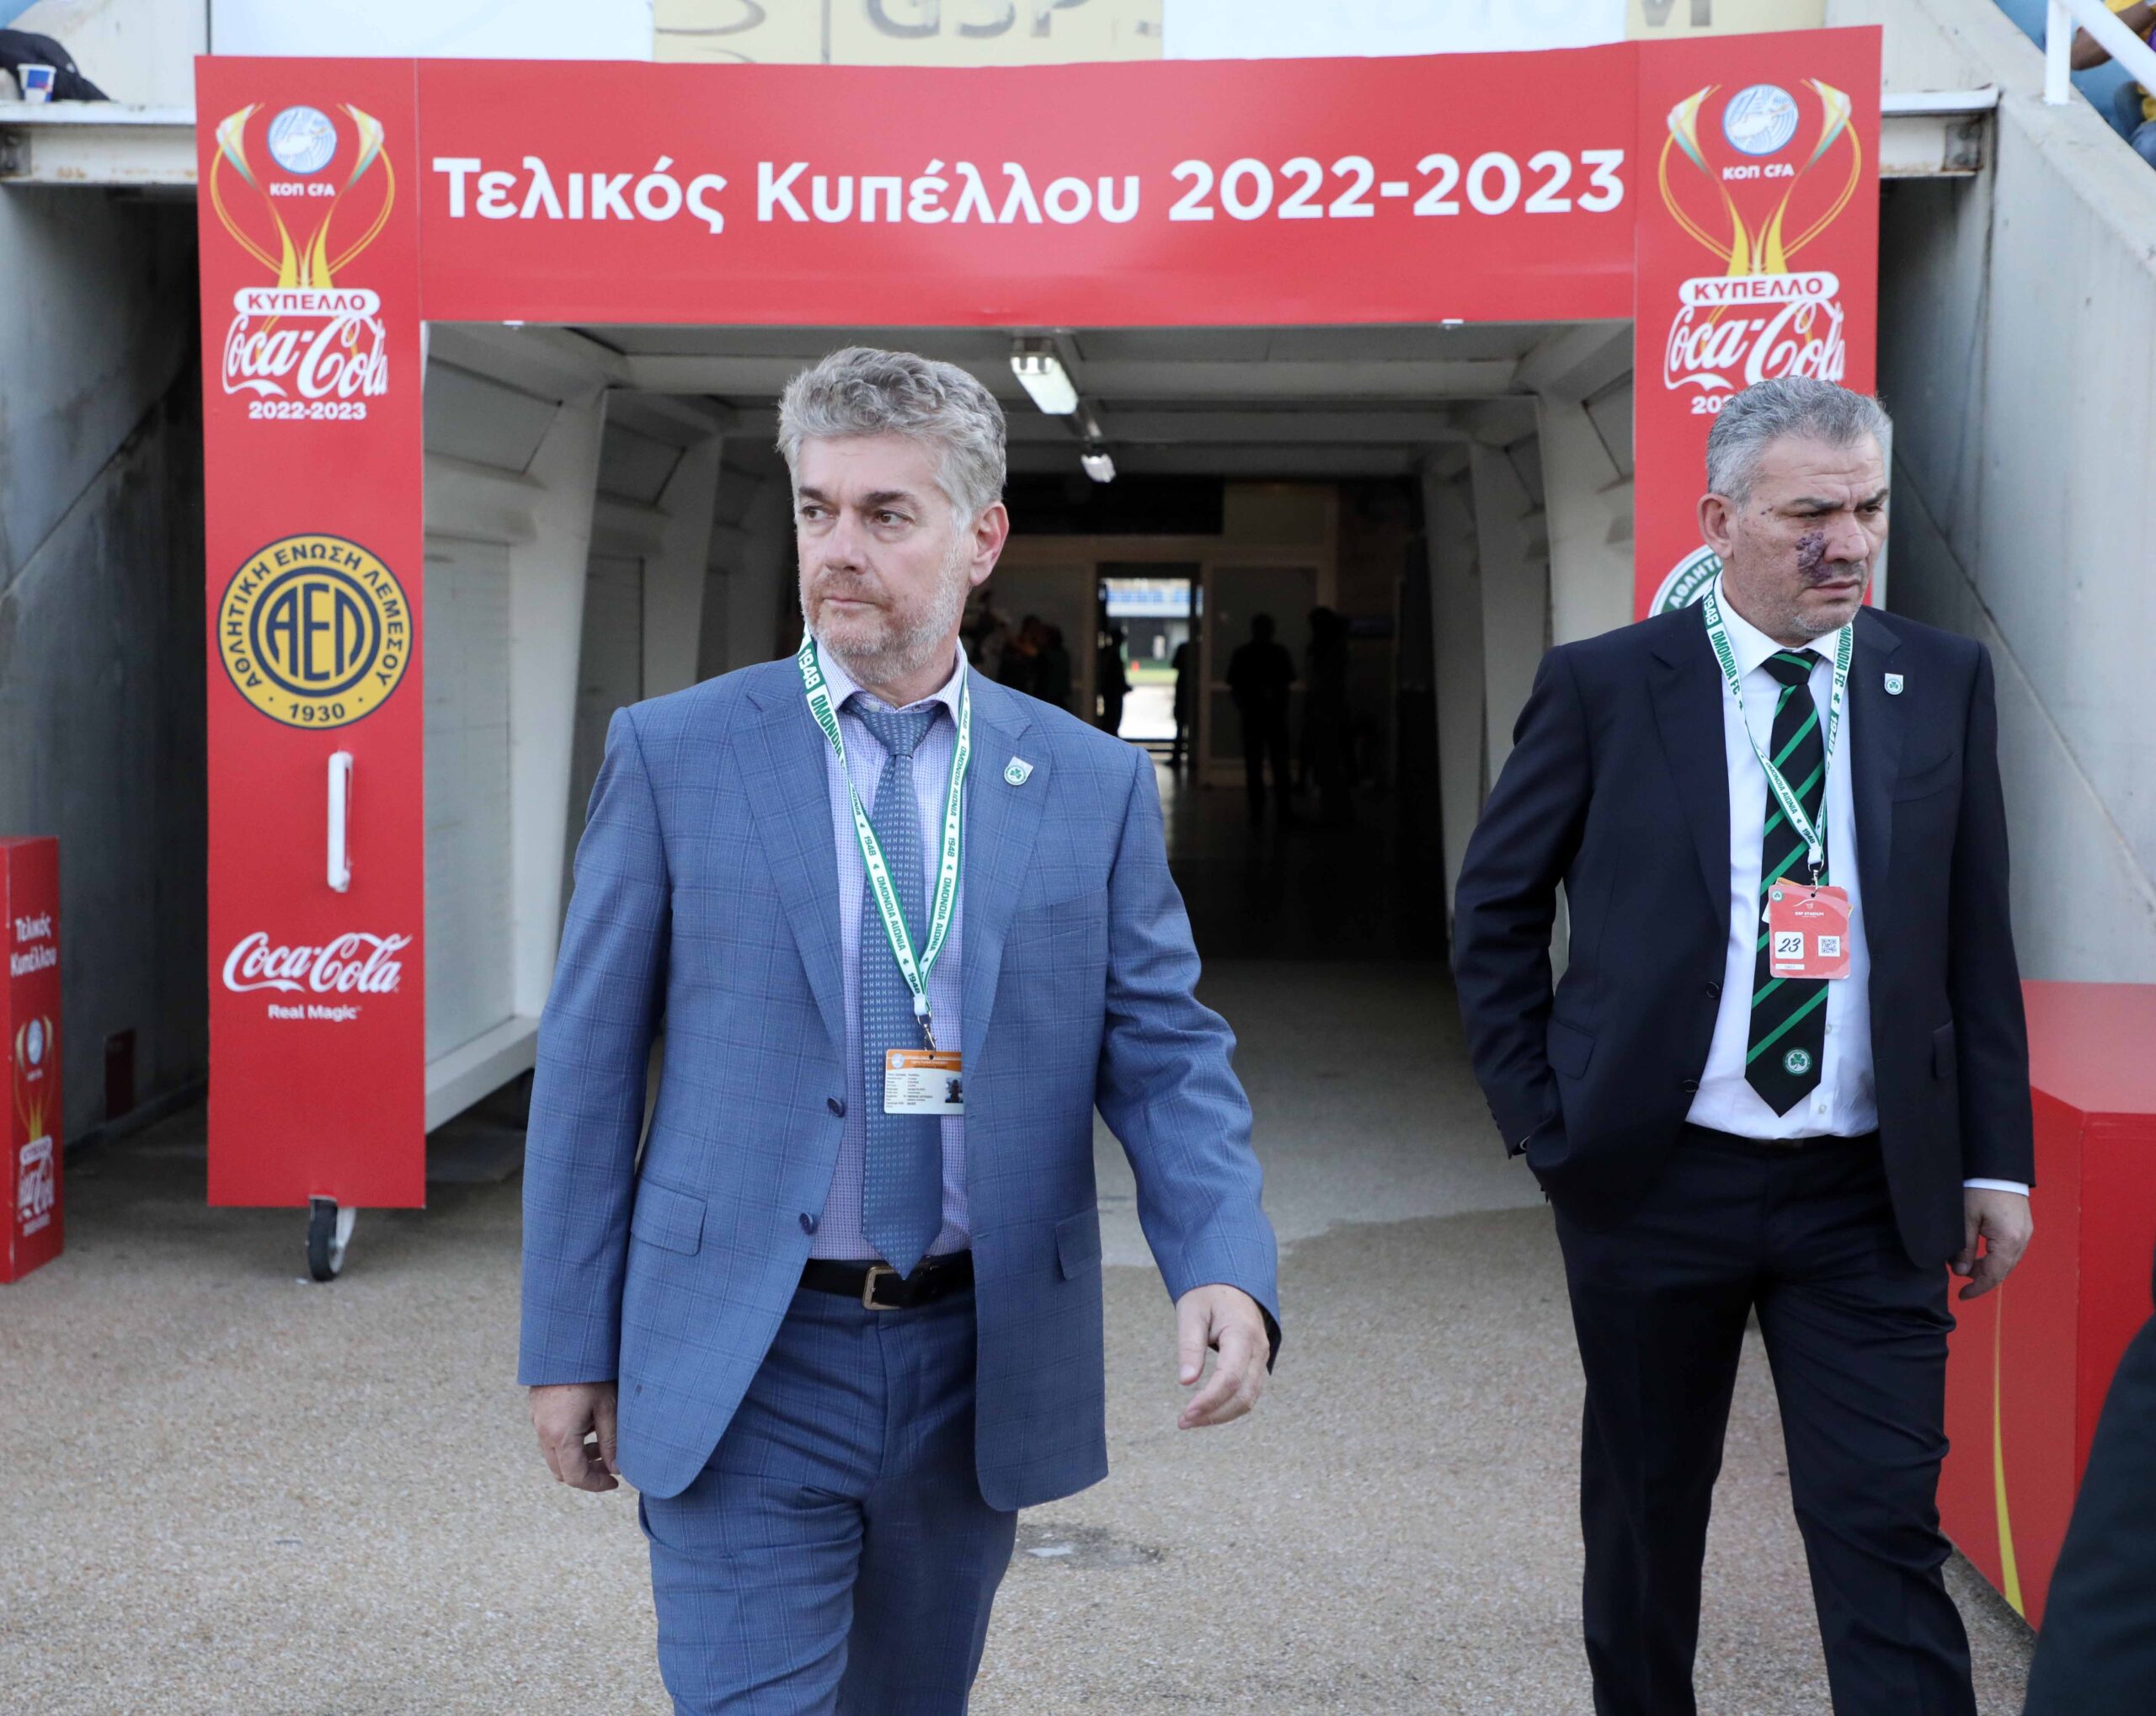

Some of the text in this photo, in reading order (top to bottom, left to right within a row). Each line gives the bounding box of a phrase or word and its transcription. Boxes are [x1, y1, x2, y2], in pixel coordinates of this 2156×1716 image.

[270, 184, 336, 196] ΚΟΠ CFA
[433, 149, 1625, 234] Τελικός Κυπέλλου 2022-2023
[1722, 163, 1795, 180] ΚΟΠ CFA
[248, 294, 366, 311] ΚΥΠΕΛΛΟ
[1694, 278, 1823, 301] ΚΥΠΕΛΛΟ
[222, 314, 388, 398] Coca-Cola
[1664, 299, 1845, 390] Coca-Cola
[248, 401, 366, 420] 2022-2023
[1669, 556, 1722, 609] ΑΘΛΗΤΙ
[227, 543, 403, 689] ΑΘΛΗΤΙΚΗ ΕΝΩΣΗ ΛΕΜΕΣΟΥ
[1704, 594, 1741, 695] 1948 OMONOIA FC
[1836, 626, 1852, 671] OMONOIA
[1834, 670, 1846, 688] FC
[289, 703, 345, 722] 1930
[798, 647, 841, 759] 1948 OMONOIA
[953, 746, 967, 789] OMONOIA
[1781, 791, 1798, 814] AIONIA
[1802, 828, 1815, 844] 1948
[947, 837, 956, 857] 1948
[863, 835, 877, 856] 1948
[876, 876, 896, 919] OMONOIA
[890, 920, 906, 951] AIONIA
[908, 973, 921, 994] 1948
[937, 877, 952, 920] OMONOIA
[929, 922, 943, 951] AIONIA
[1778, 938, 1801, 952] 23
[222, 931, 413, 993] Coca-Cola
[268, 1004, 305, 1019] Real
